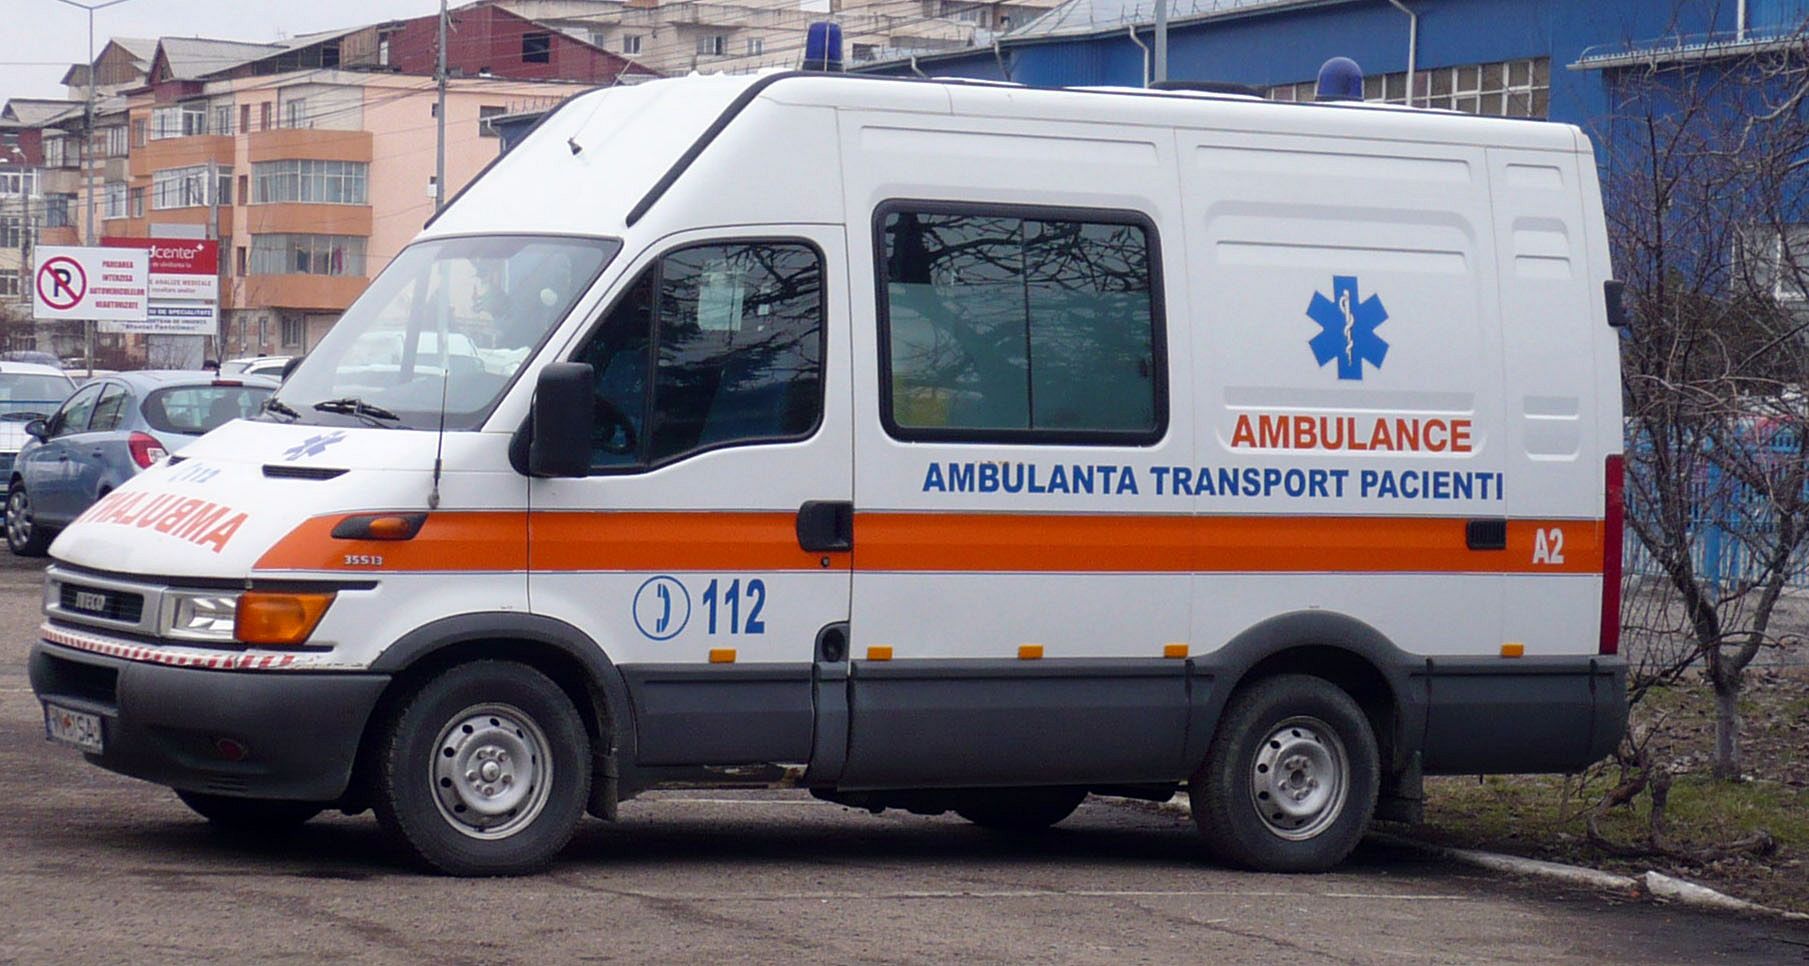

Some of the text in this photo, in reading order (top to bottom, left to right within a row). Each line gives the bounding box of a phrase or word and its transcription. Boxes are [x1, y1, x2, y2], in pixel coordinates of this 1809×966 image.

[1231, 414, 1473, 452] AMBULANCE
[922, 461, 1504, 501] AMBULANTA TRANSPORT PACIENTI
[1532, 527, 1565, 565] A2
[702, 577, 766, 635] 112
